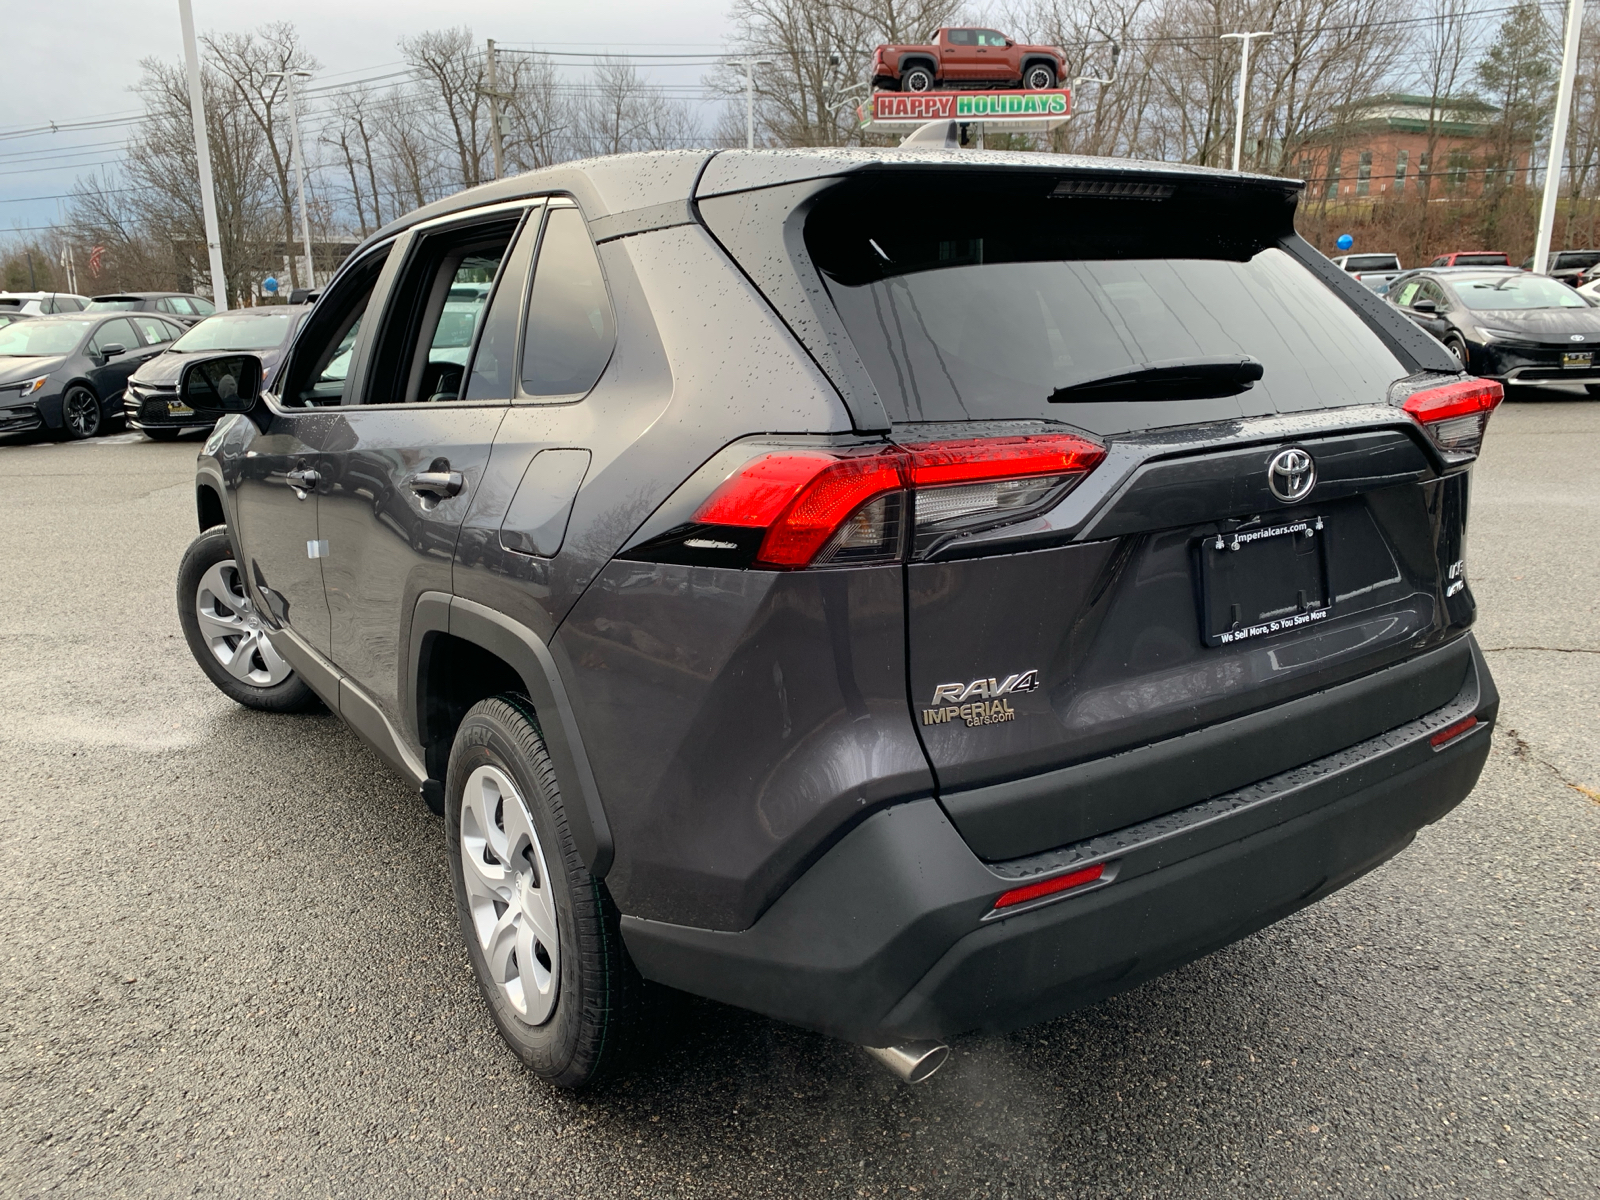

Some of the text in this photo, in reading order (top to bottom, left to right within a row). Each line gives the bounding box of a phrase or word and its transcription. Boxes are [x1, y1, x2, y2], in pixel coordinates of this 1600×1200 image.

[878, 94, 1066, 117] HAPPY HOLIDAYS
[1234, 523, 1307, 542] Imperialcars.com
[1221, 610, 1327, 643] We Sell More, So You Save More
[931, 669, 1039, 705] RAV4
[922, 698, 1015, 726] IMPERIAL
[966, 712, 1015, 728] cars.com
